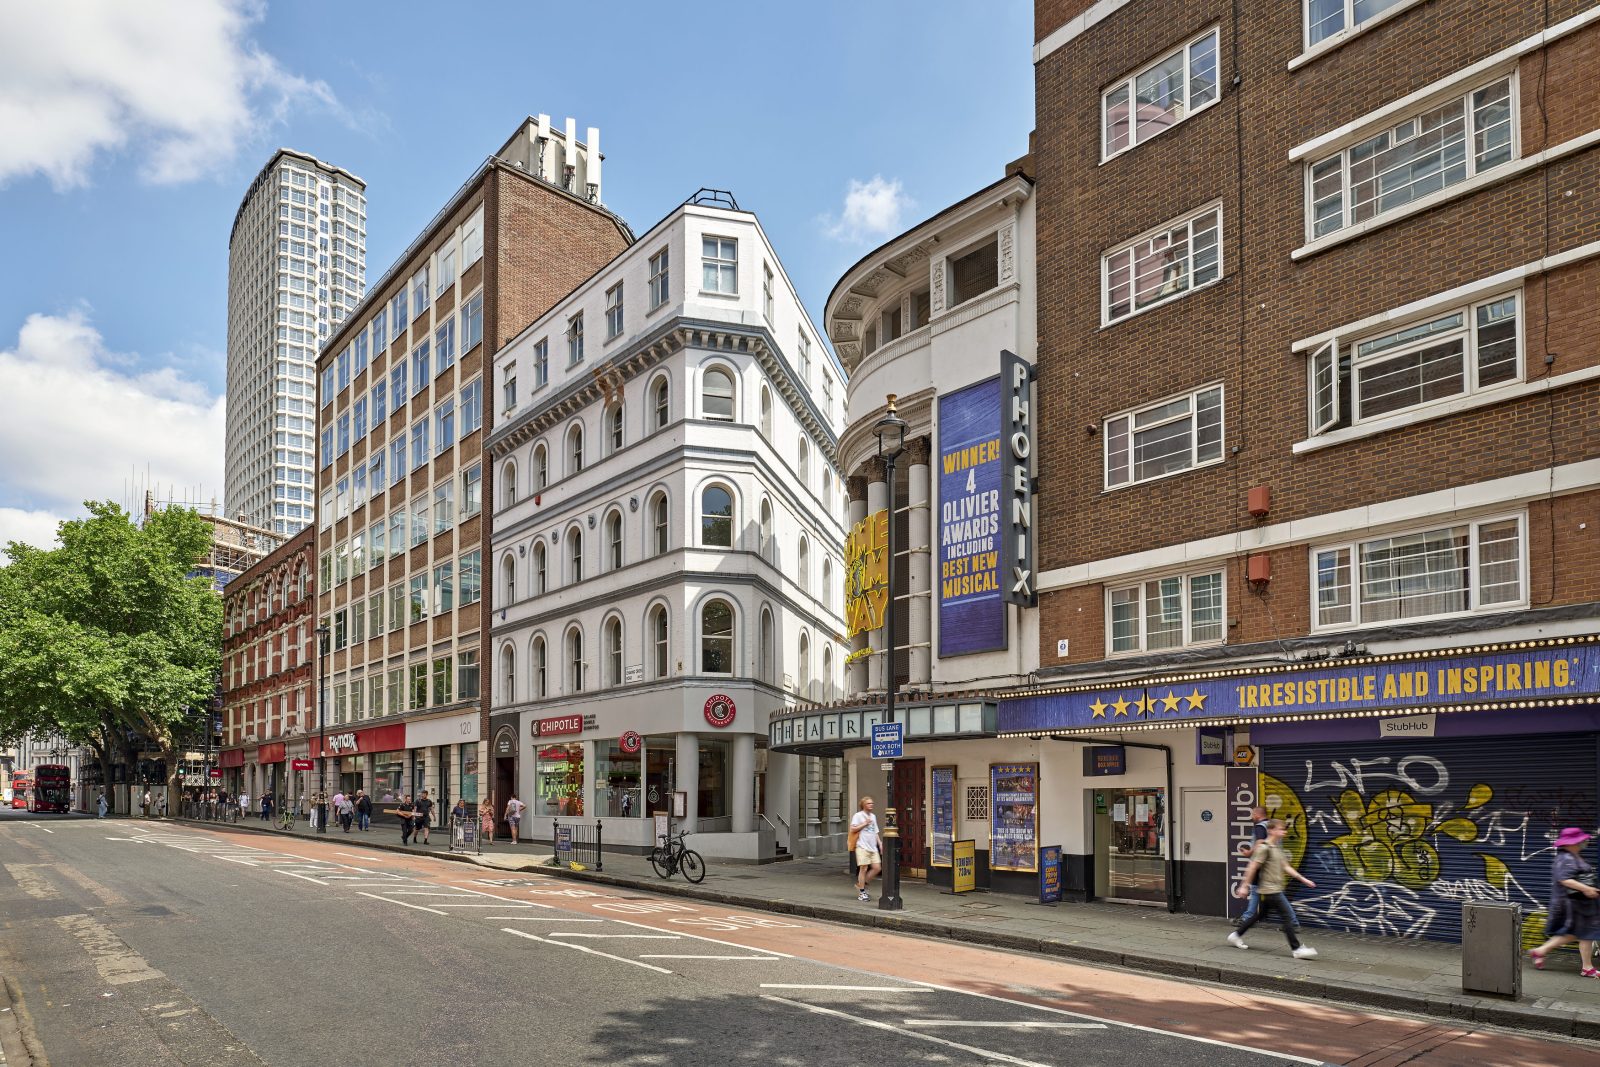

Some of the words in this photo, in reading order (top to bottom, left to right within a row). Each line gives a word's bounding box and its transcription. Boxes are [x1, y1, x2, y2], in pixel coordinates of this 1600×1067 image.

[943, 439, 1000, 475] WINNER!
[965, 468, 976, 494] 4
[1011, 362, 1030, 596] PHOENIX
[943, 489, 1000, 523] OLIVIER
[942, 513, 999, 546] AWARDS
[947, 536, 994, 559] INCLUDING
[942, 557, 969, 579] BEST
[972, 550, 999, 572] NEW
[942, 570, 999, 599] MUSICAL
[1383, 671, 1429, 699] AND
[706, 695, 735, 708] CHIPOTLE
[460, 722, 472, 735] 120
[541, 718, 579, 732] CHIPOTLE
[1386, 721, 1428, 731] StubHub
